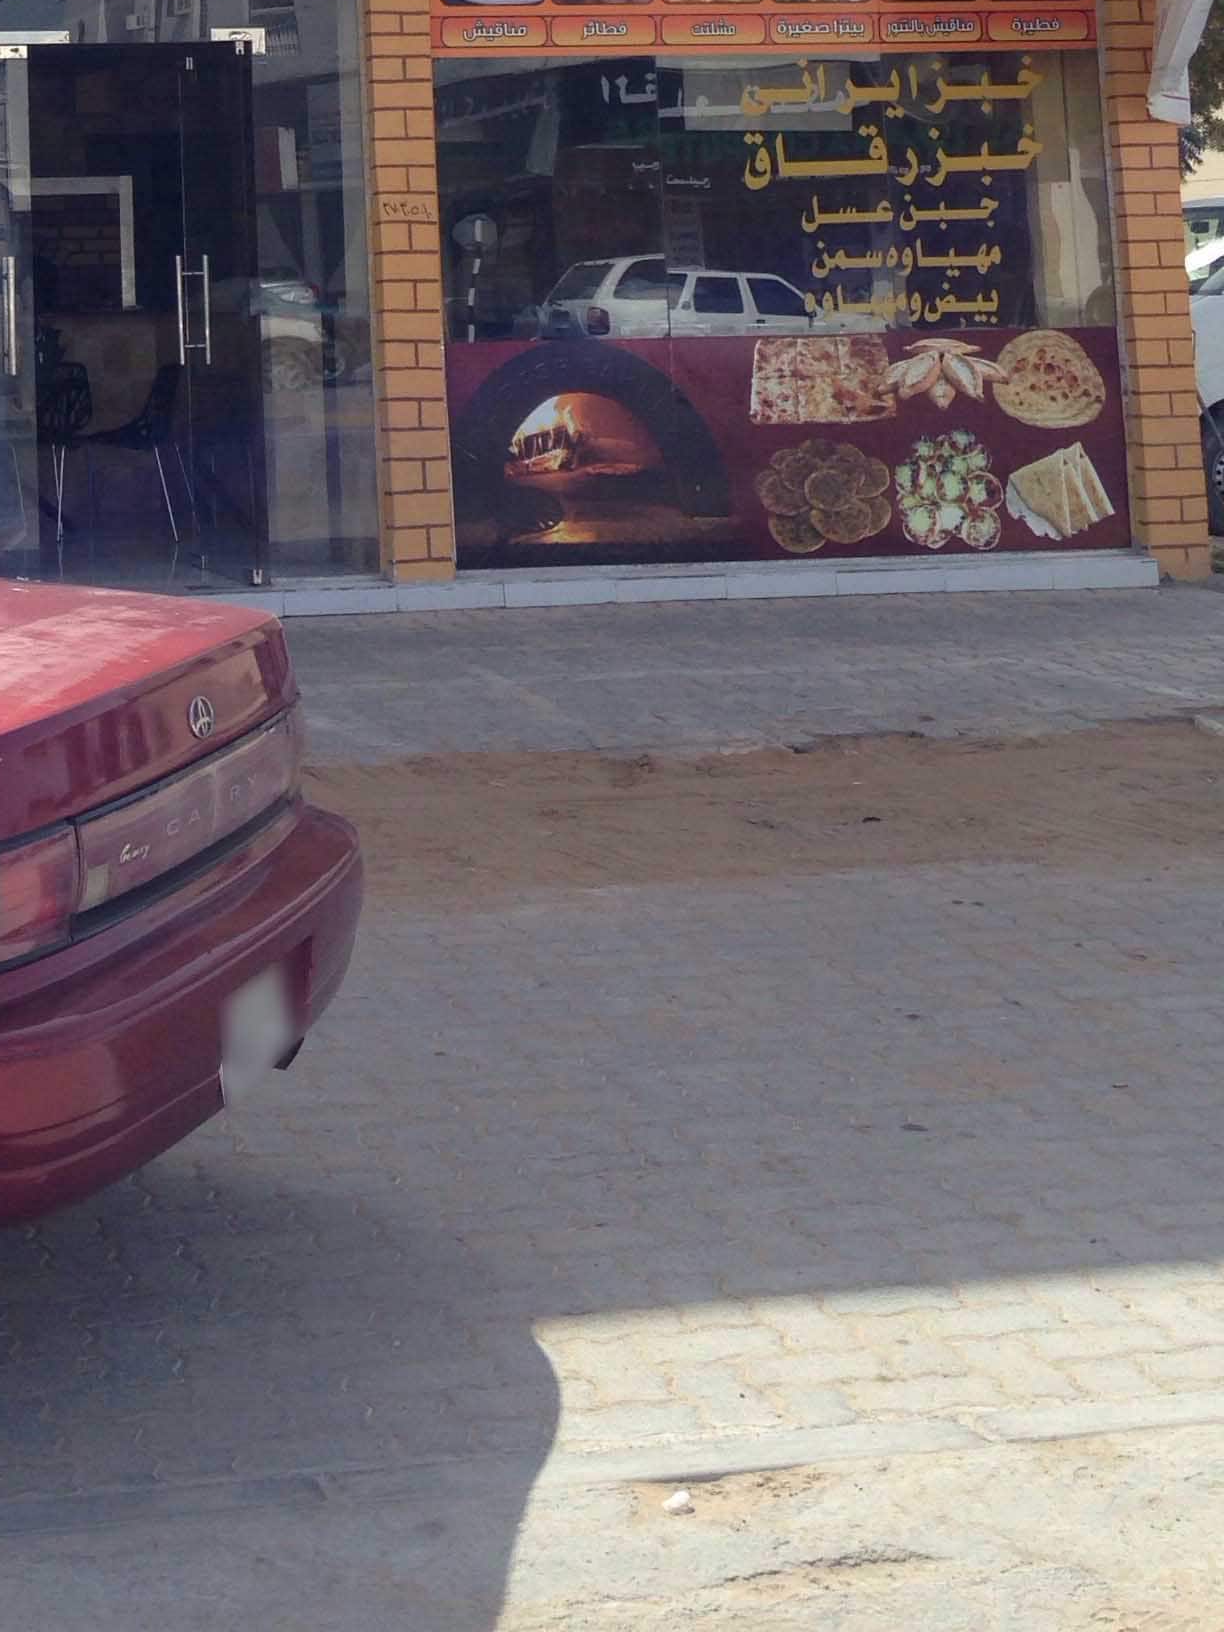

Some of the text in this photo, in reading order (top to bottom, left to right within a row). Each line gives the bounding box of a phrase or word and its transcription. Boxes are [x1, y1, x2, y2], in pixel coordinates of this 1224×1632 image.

[463, 21, 527, 41] مناقيش
[926, 56, 1044, 114] خبز
[743, 124, 1044, 190] خبز رقاق
[801, 194, 999, 233] جبن عسل
